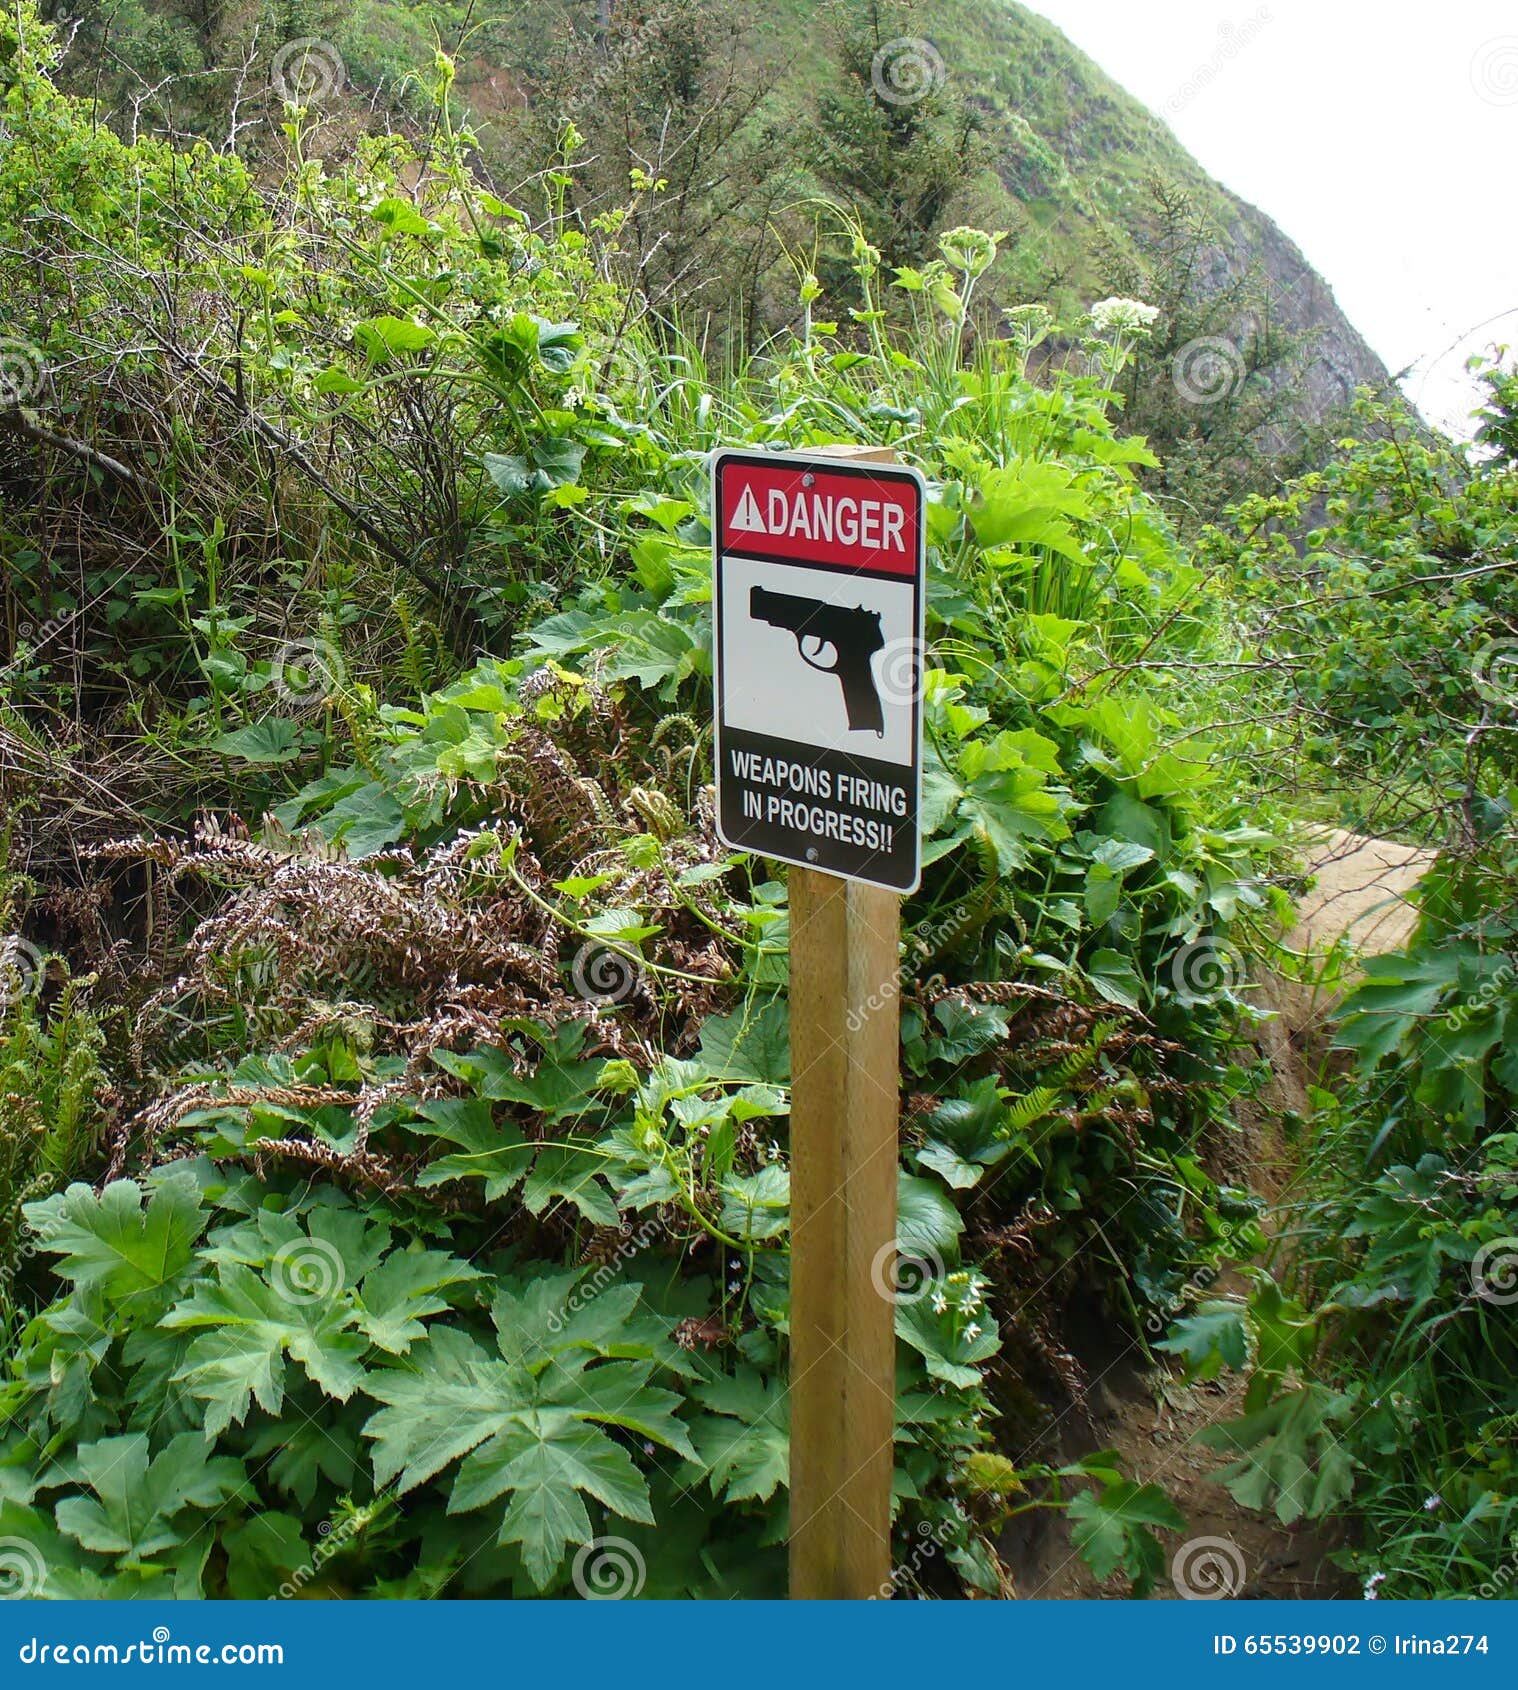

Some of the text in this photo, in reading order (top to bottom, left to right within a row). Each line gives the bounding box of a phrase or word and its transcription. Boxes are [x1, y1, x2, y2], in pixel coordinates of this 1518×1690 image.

[768, 488, 906, 552] DANGER
[731, 749, 907, 817] WEAPONS FIRING
[743, 789, 893, 854] IN PROGRESS!!
